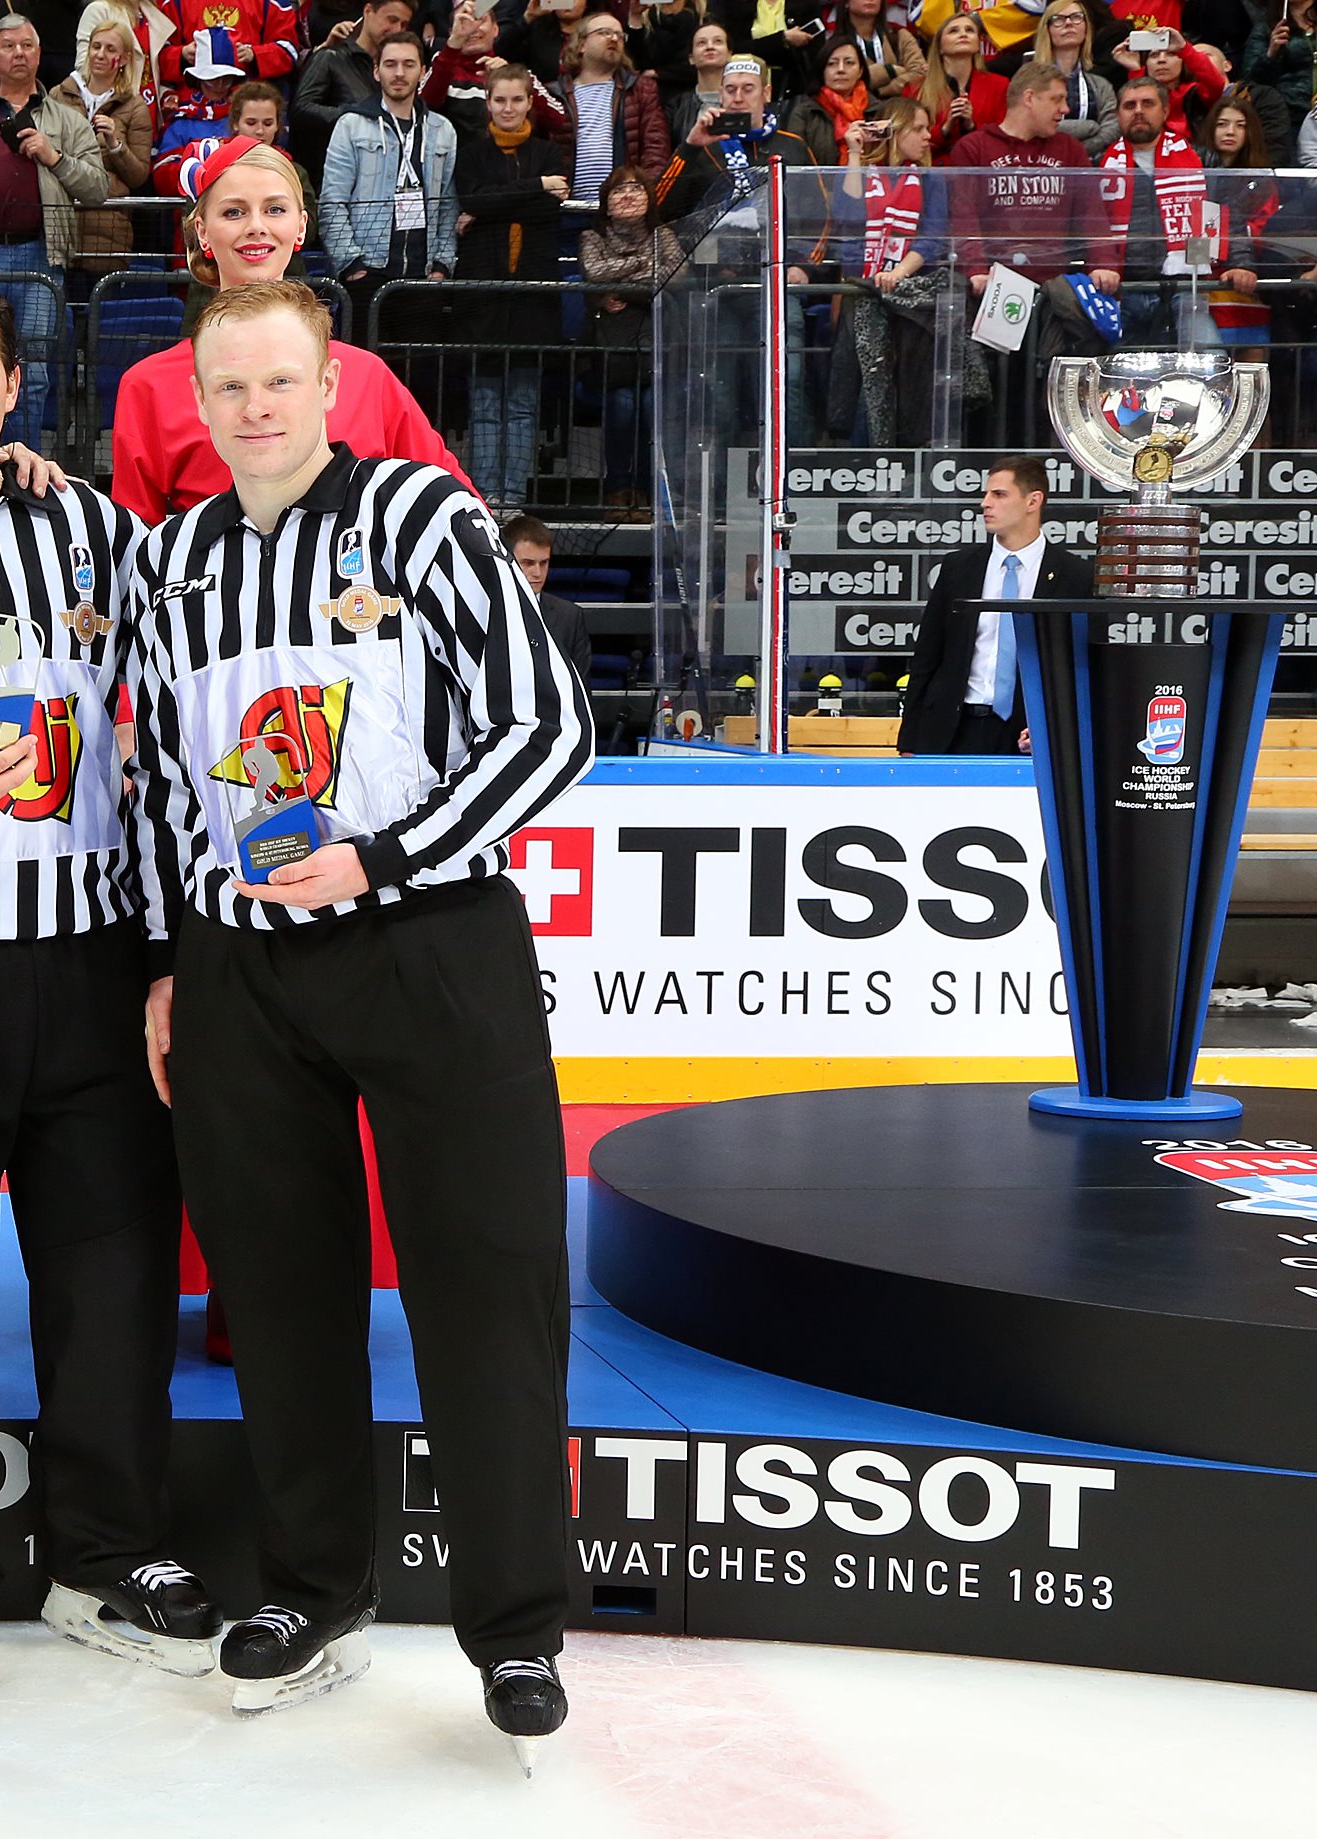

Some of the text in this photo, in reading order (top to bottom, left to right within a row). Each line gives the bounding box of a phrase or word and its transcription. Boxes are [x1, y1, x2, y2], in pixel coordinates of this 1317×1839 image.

[988, 176, 1018, 195] BEN
[994, 196, 1014, 206] AND
[1161, 204, 1192, 217] TEA
[755, 457, 905, 492] eresit
[847, 509, 987, 544] Ceresit
[754, 560, 902, 595] eresit
[1155, 685, 1183, 696] 2016
[1154, 704, 1181, 715] IIHF
[1131, 765, 1191, 775] ICE HOCKEY
[1143, 774, 1181, 784] WORLD
[1122, 781, 1195, 792] CHAMPIONSHIP
[1145, 792, 1178, 801] RUSSIA
[1115, 800, 1147, 809] Moscow
[619, 826, 1055, 941] TISS
[594, 971, 891, 1016] WATCHES
[930, 971, 1071, 1016] SINC
[1141, 1139, 1313, 1151] 2016
[1195, 1158, 1317, 1170] IIH
[595, 1437, 1115, 1549] TISSOT
[577, 1539, 1114, 1610] WATCHES SINCE 1853
